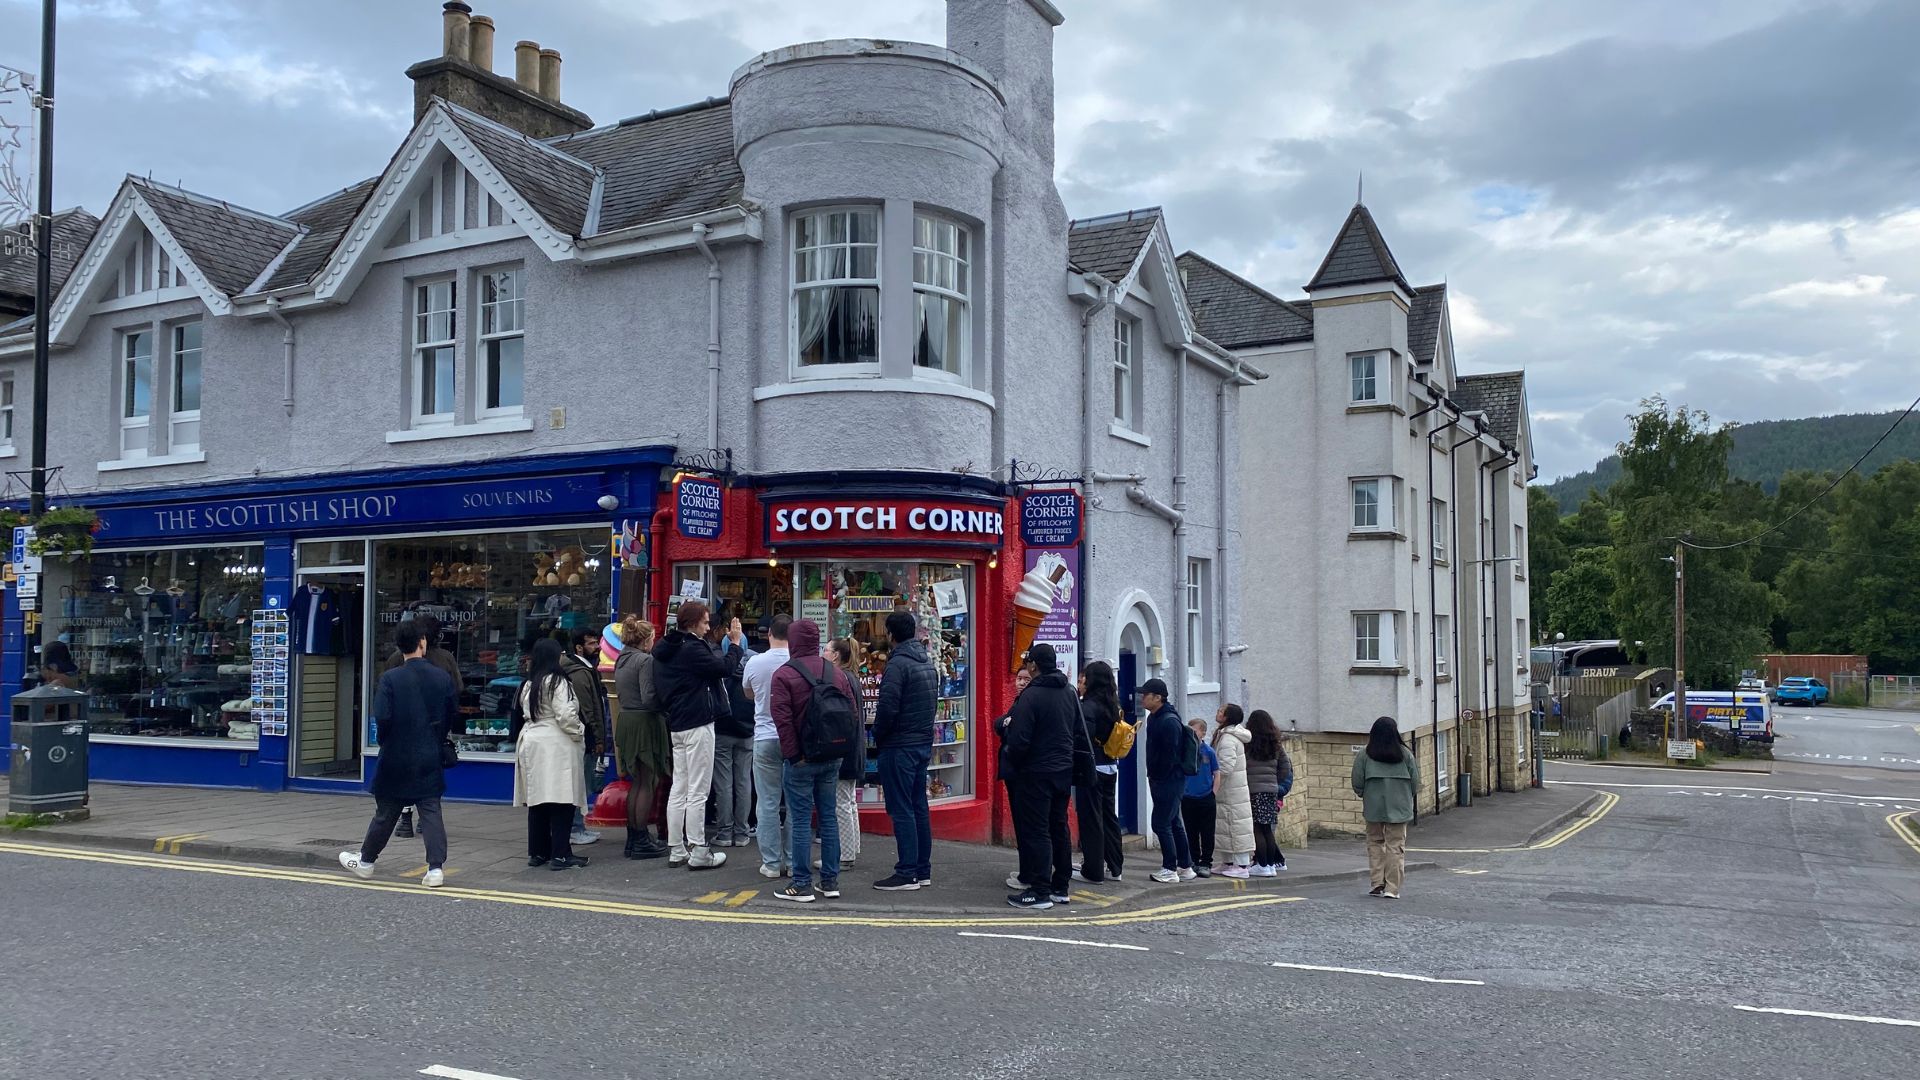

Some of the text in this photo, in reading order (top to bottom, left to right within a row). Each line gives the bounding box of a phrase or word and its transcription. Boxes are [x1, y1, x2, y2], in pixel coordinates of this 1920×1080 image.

[681, 482, 720, 498] SCOTCH
[463, 489, 553, 508] SOUVENIRS
[681, 494, 720, 510] CORNER
[1026, 495, 1075, 507] SCOTCH
[154, 495, 397, 531] THE SCOTTISH SHOP
[682, 508, 690, 517] OF
[1025, 506, 1075, 518] CORNER
[776, 507, 1004, 535] SCOTCH CORNER
[1038, 519, 1073, 527] PITLOCHRY
[1034, 535, 1065, 543] ICE CREAM
[379, 611, 399, 623] THE
[450, 610, 478, 622] SHOP
[1055, 644, 1074, 654] CREAM
[1581, 667, 1619, 678] BRAUN
